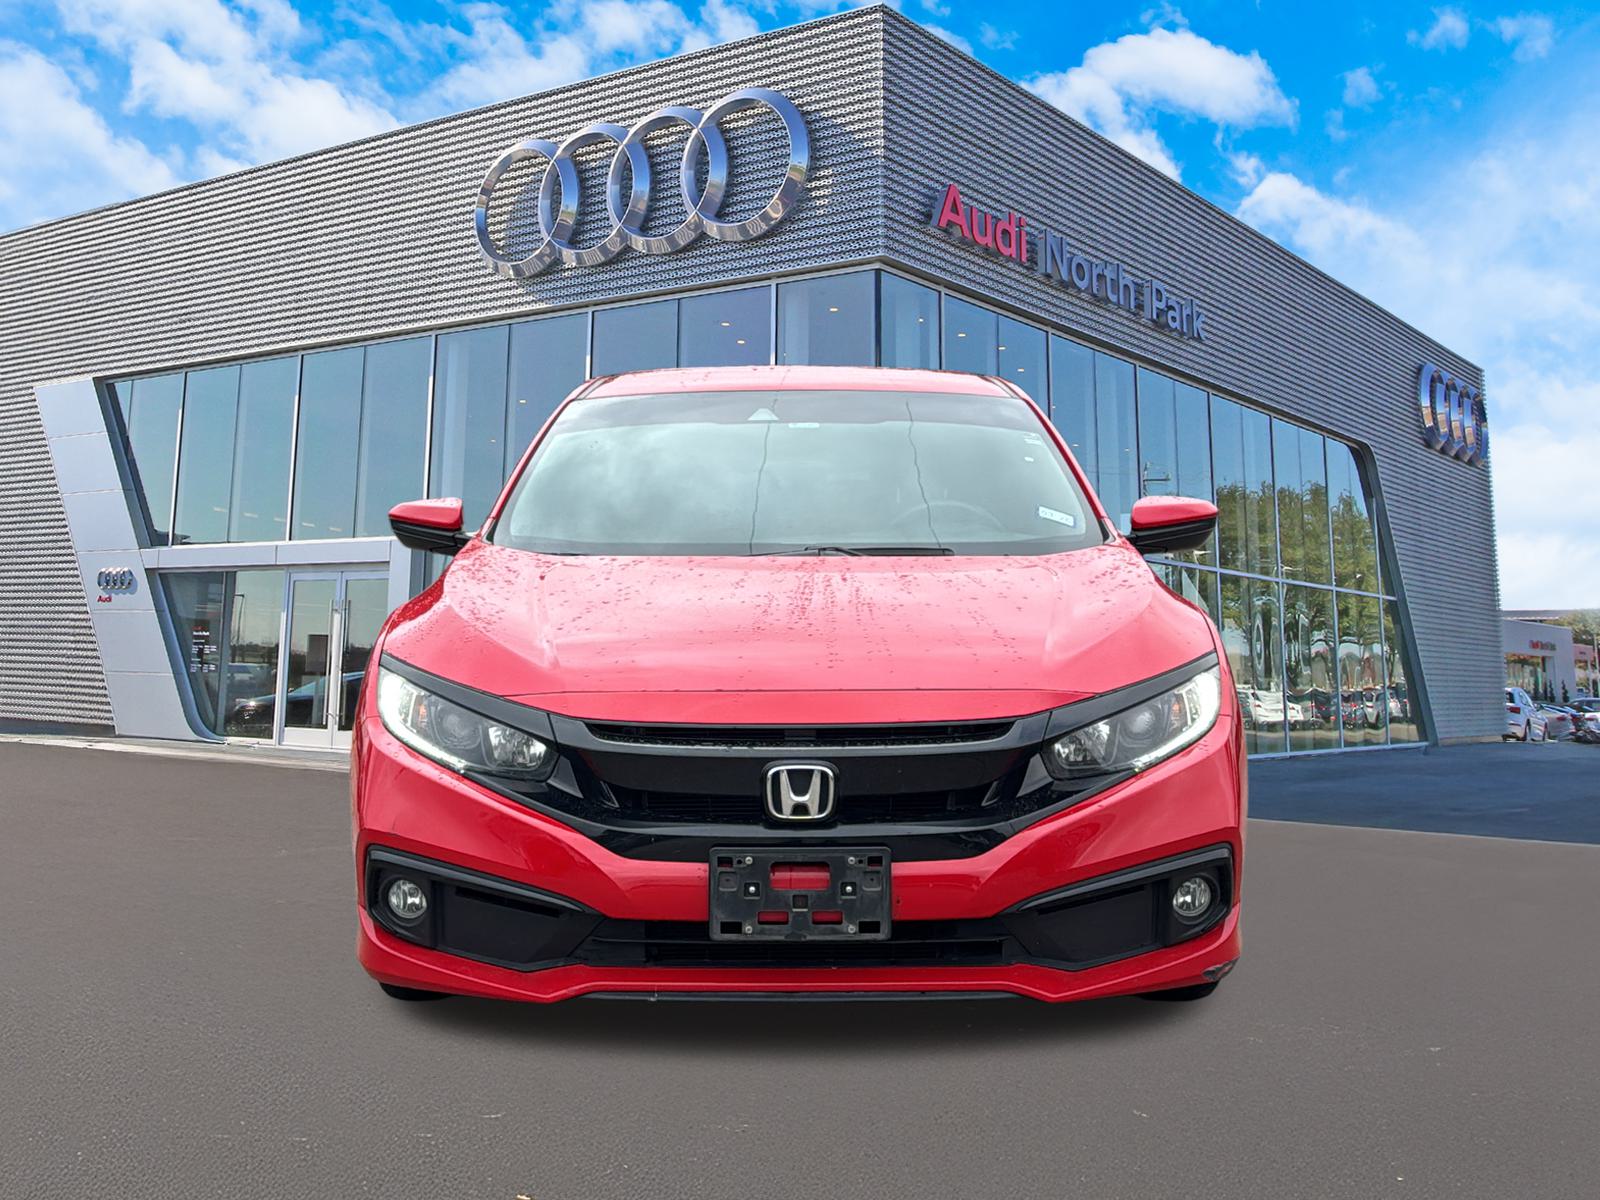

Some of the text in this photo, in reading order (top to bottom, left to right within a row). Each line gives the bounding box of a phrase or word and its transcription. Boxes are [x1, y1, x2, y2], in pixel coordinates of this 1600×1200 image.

[934, 183, 1207, 341] Audi North Park
